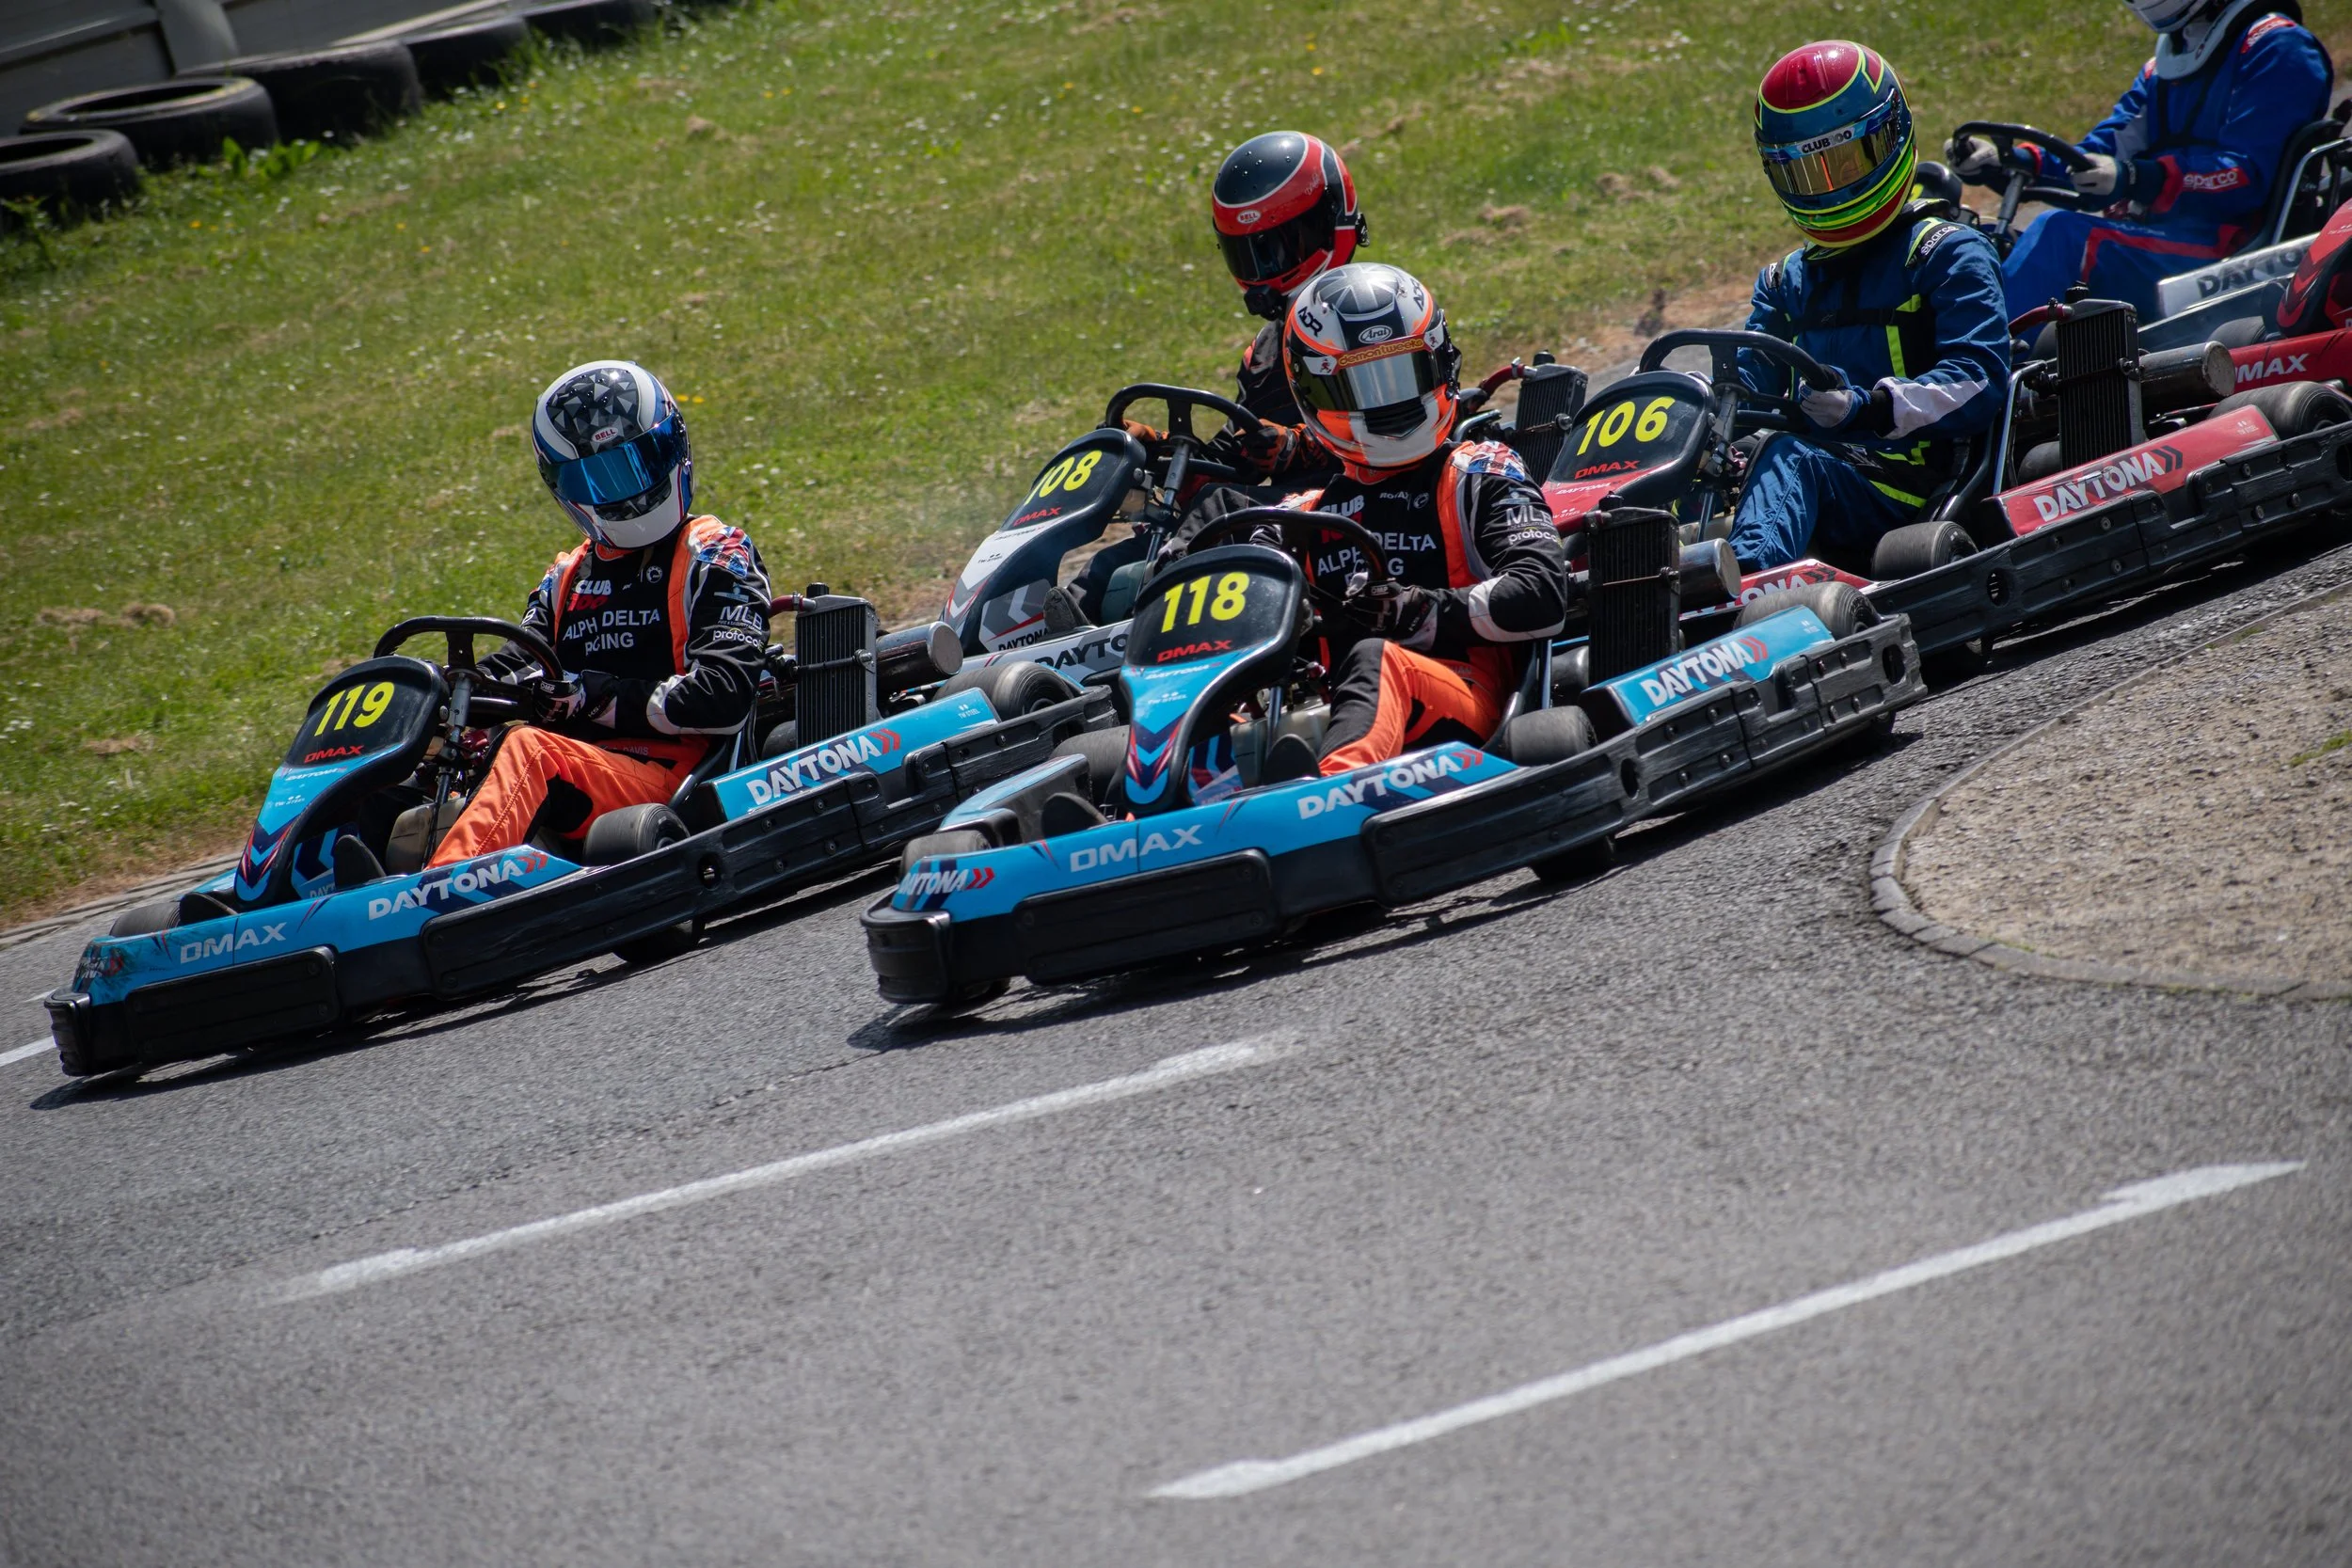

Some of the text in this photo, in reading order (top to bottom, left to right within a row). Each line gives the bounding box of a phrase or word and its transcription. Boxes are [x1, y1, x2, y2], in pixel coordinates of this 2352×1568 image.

[2183, 170, 2238, 190] sparco
[1239, 211, 1259, 222] BELL
[1920, 225, 1960, 257] sparco
[2196, 248, 2303, 298] DAYTO
[1363, 327, 1387, 340] Arai
[1339, 339, 1423, 367] demontweeks
[2234, 353, 2311, 385] MAX
[595, 428, 616, 441] BELL
[1577, 396, 1676, 456] 106
[1023, 450, 1103, 506] 108
[1574, 460, 1641, 480] DMAX
[2033, 451, 2165, 522] DAYTONA
[1013, 506, 1062, 527] DMAX
[1507, 529, 1558, 545] protoco
[575, 579, 612, 595] CLUB
[567, 594, 610, 611] 100
[1161, 571, 1249, 633] 118
[602, 608, 660, 627] DELTA
[719, 605, 763, 630] MLB
[1035, 633, 1129, 670] DAYTO
[1157, 640, 1232, 662] DMAX
[540, 681, 556, 694] OMP
[1640, 641, 1756, 706] DAYTONA
[314, 681, 394, 736] 119
[304, 745, 364, 764] DMAX
[746, 735, 883, 805] DAYTONA
[1297, 755, 1460, 819] DAYTONA
[1070, 825, 1203, 872] DMAX
[310, 882, 337, 898] DAYT
[369, 860, 524, 921] DAYTONA
[180, 922, 287, 964] DMAX
